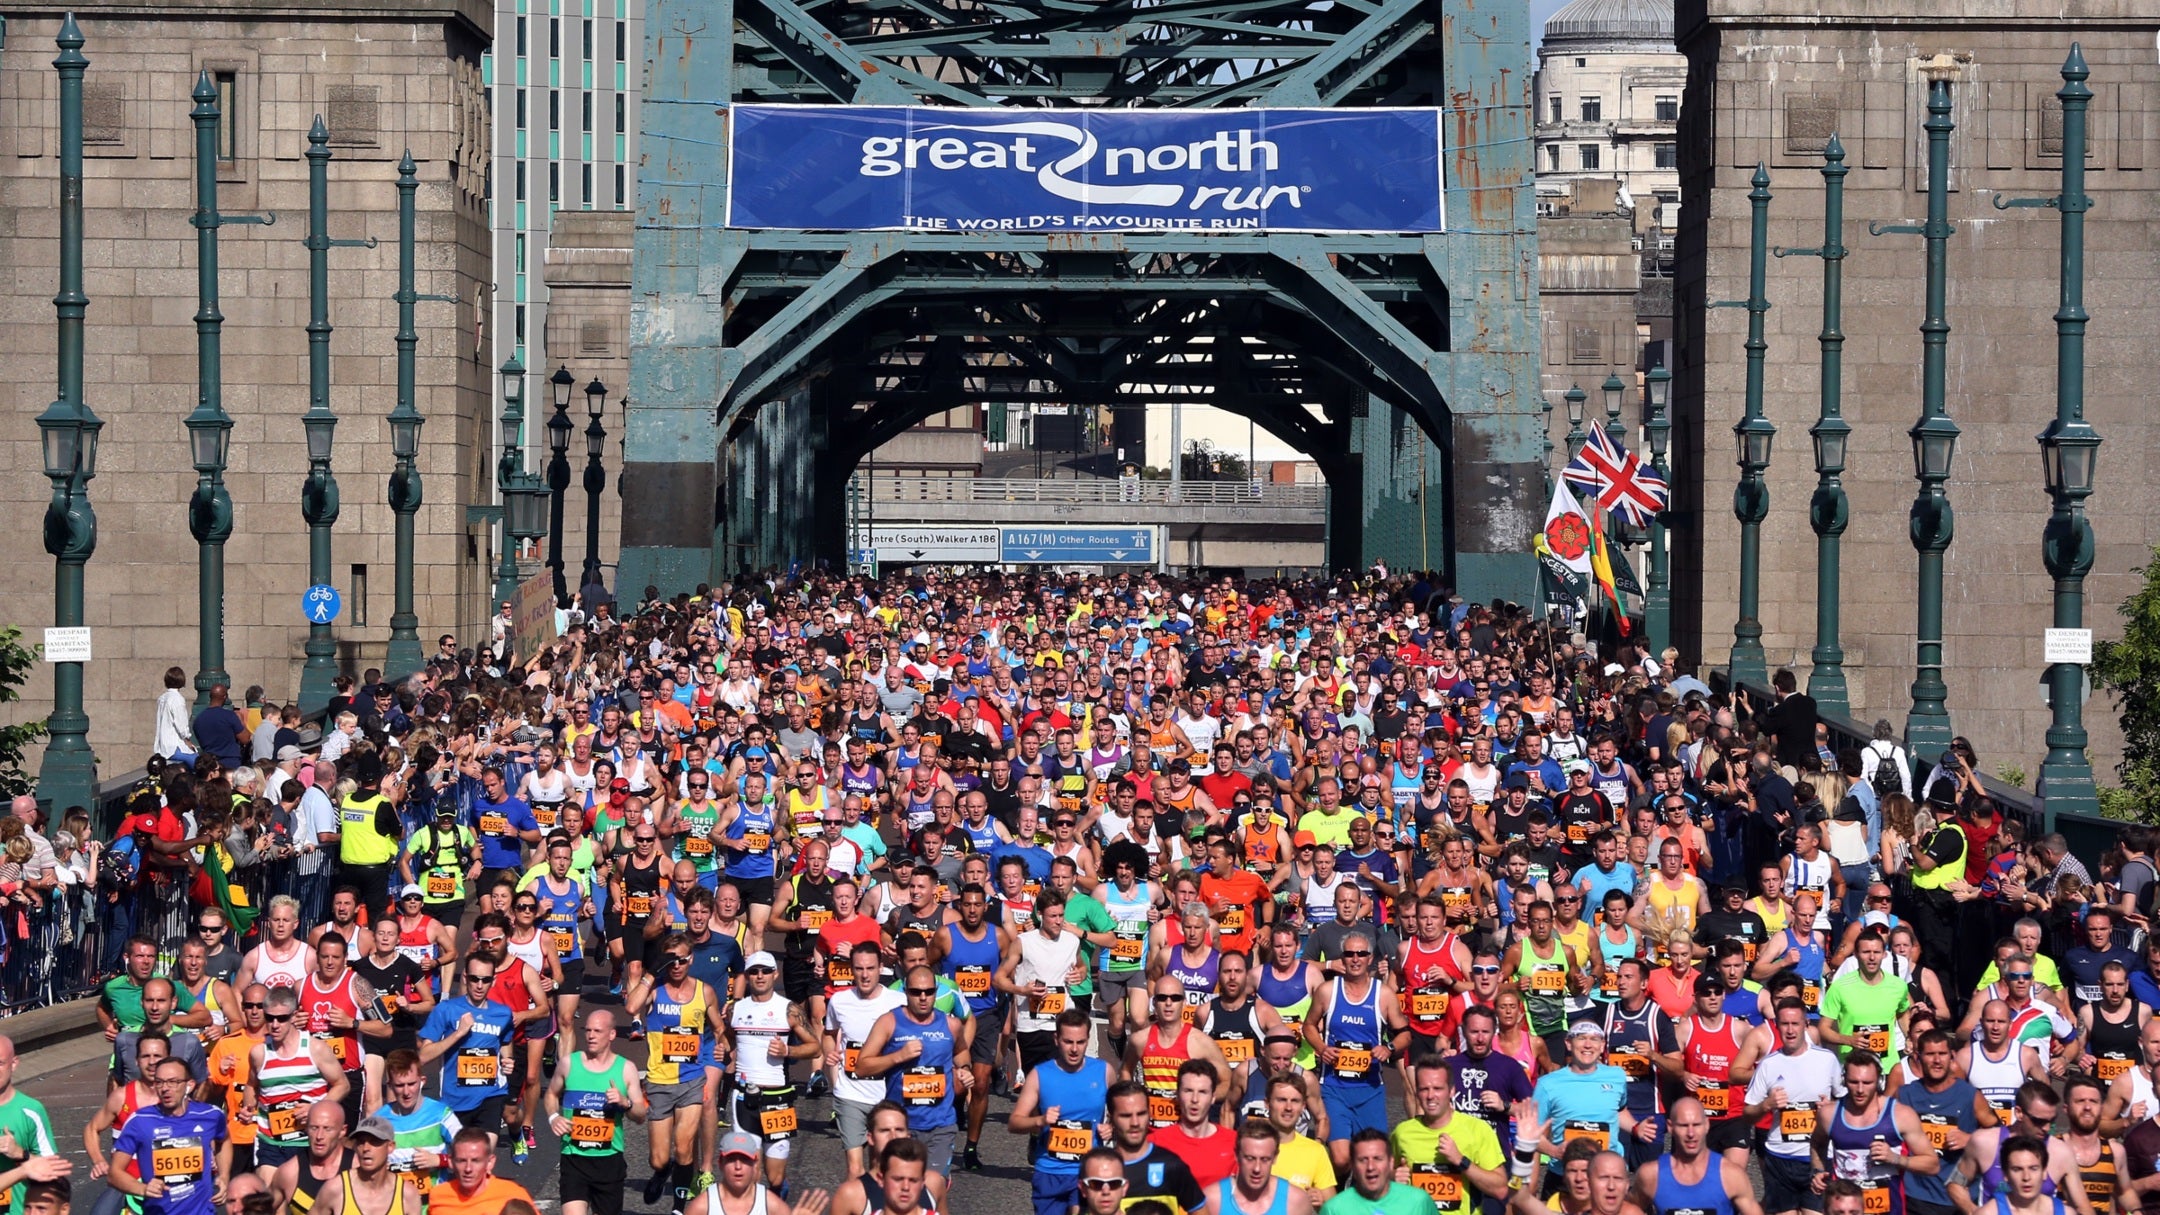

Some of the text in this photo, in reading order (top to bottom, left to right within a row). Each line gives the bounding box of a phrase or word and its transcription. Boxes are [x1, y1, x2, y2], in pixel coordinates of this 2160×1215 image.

[859, 129, 1279, 177] great north
[902, 215, 1258, 230] THE WORLD'S FAVOURITE RUN
[936, 534, 968, 543] Walker
[970, 535, 978, 543] A
[979, 535, 996, 543] 186
[1008, 533, 1016, 544] A
[1059, 535, 1085, 544] Other
[1088, 535, 1120, 544] Routes
[1540, 555, 1579, 586] CESTER
[1573, 806, 1591, 815] RICH
[345, 813, 364, 822] POLICE
[689, 842, 711, 851] 3335
[430, 882, 453, 891] 2938
[1117, 921, 1140, 932] PAUL
[1114, 943, 1140, 955] 5453
[265, 976, 293, 989] RADIO
[959, 978, 987, 989] 4829
[1536, 976, 1562, 988] 5115
[657, 1003, 681, 1016] MARK
[1416, 999, 1446, 1010] 3473
[1341, 1014, 1366, 1026] PAUL
[456, 1019, 501, 1037] ERAN
[667, 1041, 696, 1053] 1206
[1870, 1037, 1886, 1048] 33
[1341, 1055, 1369, 1069] 2549
[1709, 1060, 1729, 1068] MOORE
[463, 1063, 494, 1075] 1506
[908, 1081, 941, 1094] 2298
[1451, 1089, 1482, 1111] Kids
[766, 1115, 793, 1130] 5133
[1784, 1117, 1816, 1130] 4847
[576, 1125, 609, 1137] 2697
[1054, 1135, 1087, 1149] 1409
[155, 1155, 200, 1171] 56165
[1420, 1181, 1456, 1195] 4929
